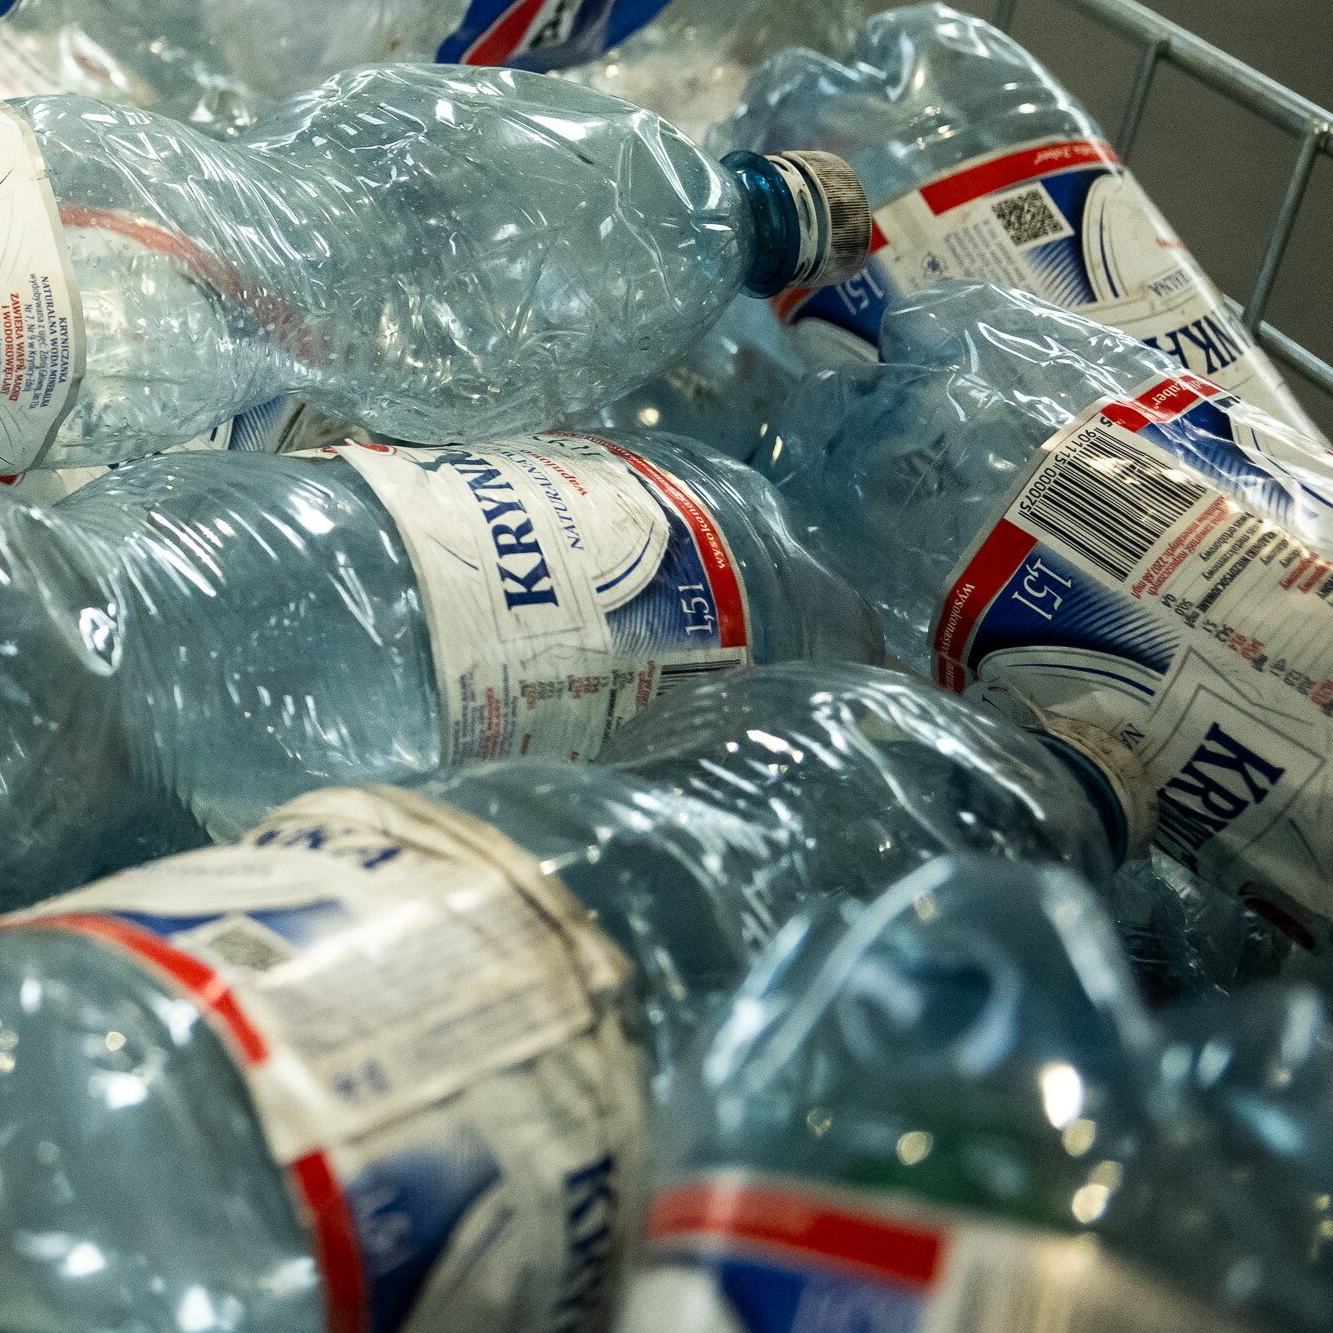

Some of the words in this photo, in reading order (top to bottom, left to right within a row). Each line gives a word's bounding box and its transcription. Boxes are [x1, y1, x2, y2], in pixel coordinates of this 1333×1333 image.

[10, 293, 22, 339] ZAWIERA
[23, 304, 31, 312] Nr
[29, 273, 43, 322] wydobywana
[40, 276, 56, 334] NATURALNA
[26, 324, 34, 333] Nr
[0, 311, 10, 394] WODOROWĘGLANY
[14, 342, 25, 373] WAPŃ,
[49, 338, 58, 367] WODA
[58, 317, 67, 383] KRYNICZANKA
[40, 370, 56, 407] MINERALNA
[1098, 415, 1114, 429] 5
[1052, 427, 1097, 467] 901115
[1017, 466, 1059, 514] 000075
[1197, 525, 1240, 564] ortoborowy
[1140, 555, 1168, 584] 2207,68
[1195, 555, 1252, 615] NIEZDYSOCJOWANE
[1173, 596, 1193, 618] 50,0
